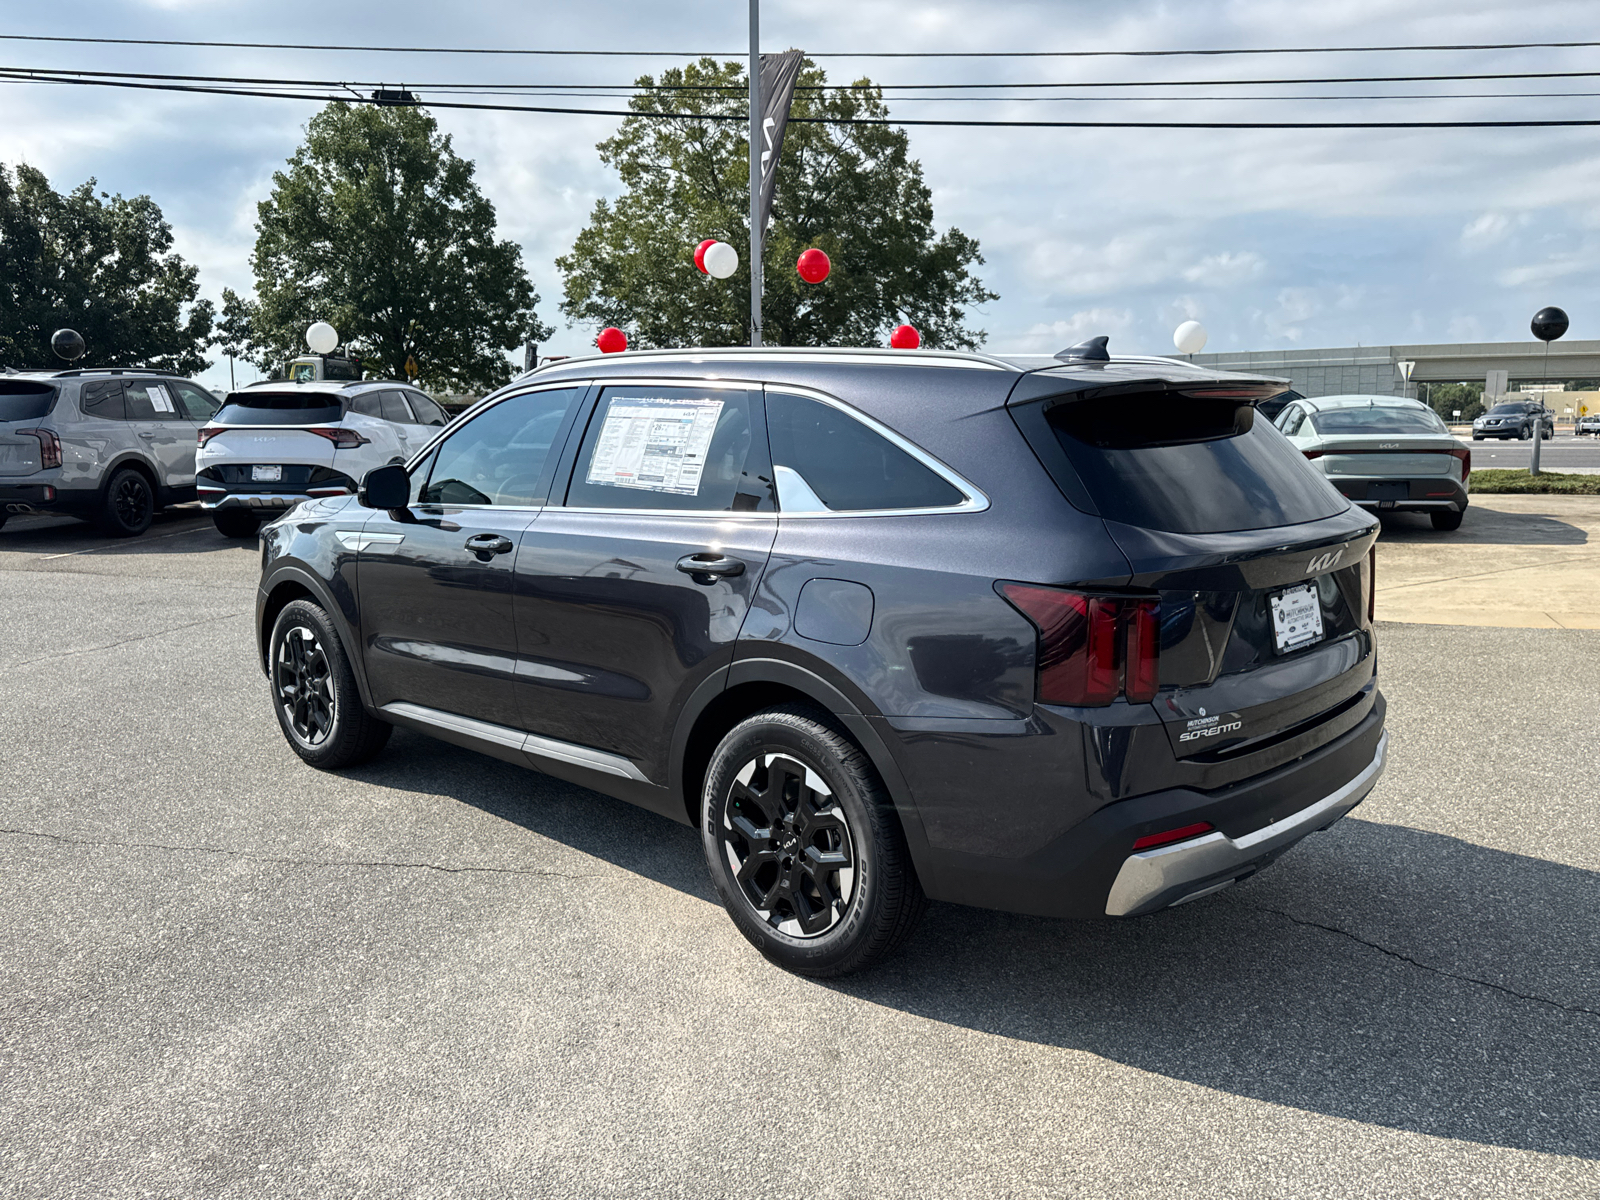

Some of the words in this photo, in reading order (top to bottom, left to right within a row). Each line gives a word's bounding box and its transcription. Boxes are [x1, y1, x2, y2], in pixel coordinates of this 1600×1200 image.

[1306, 549, 1343, 574] KIA
[1187, 716, 1219, 727] HUTCHINSON
[1179, 721, 1242, 742] SORENTO
[783, 837, 796, 849] KIA
